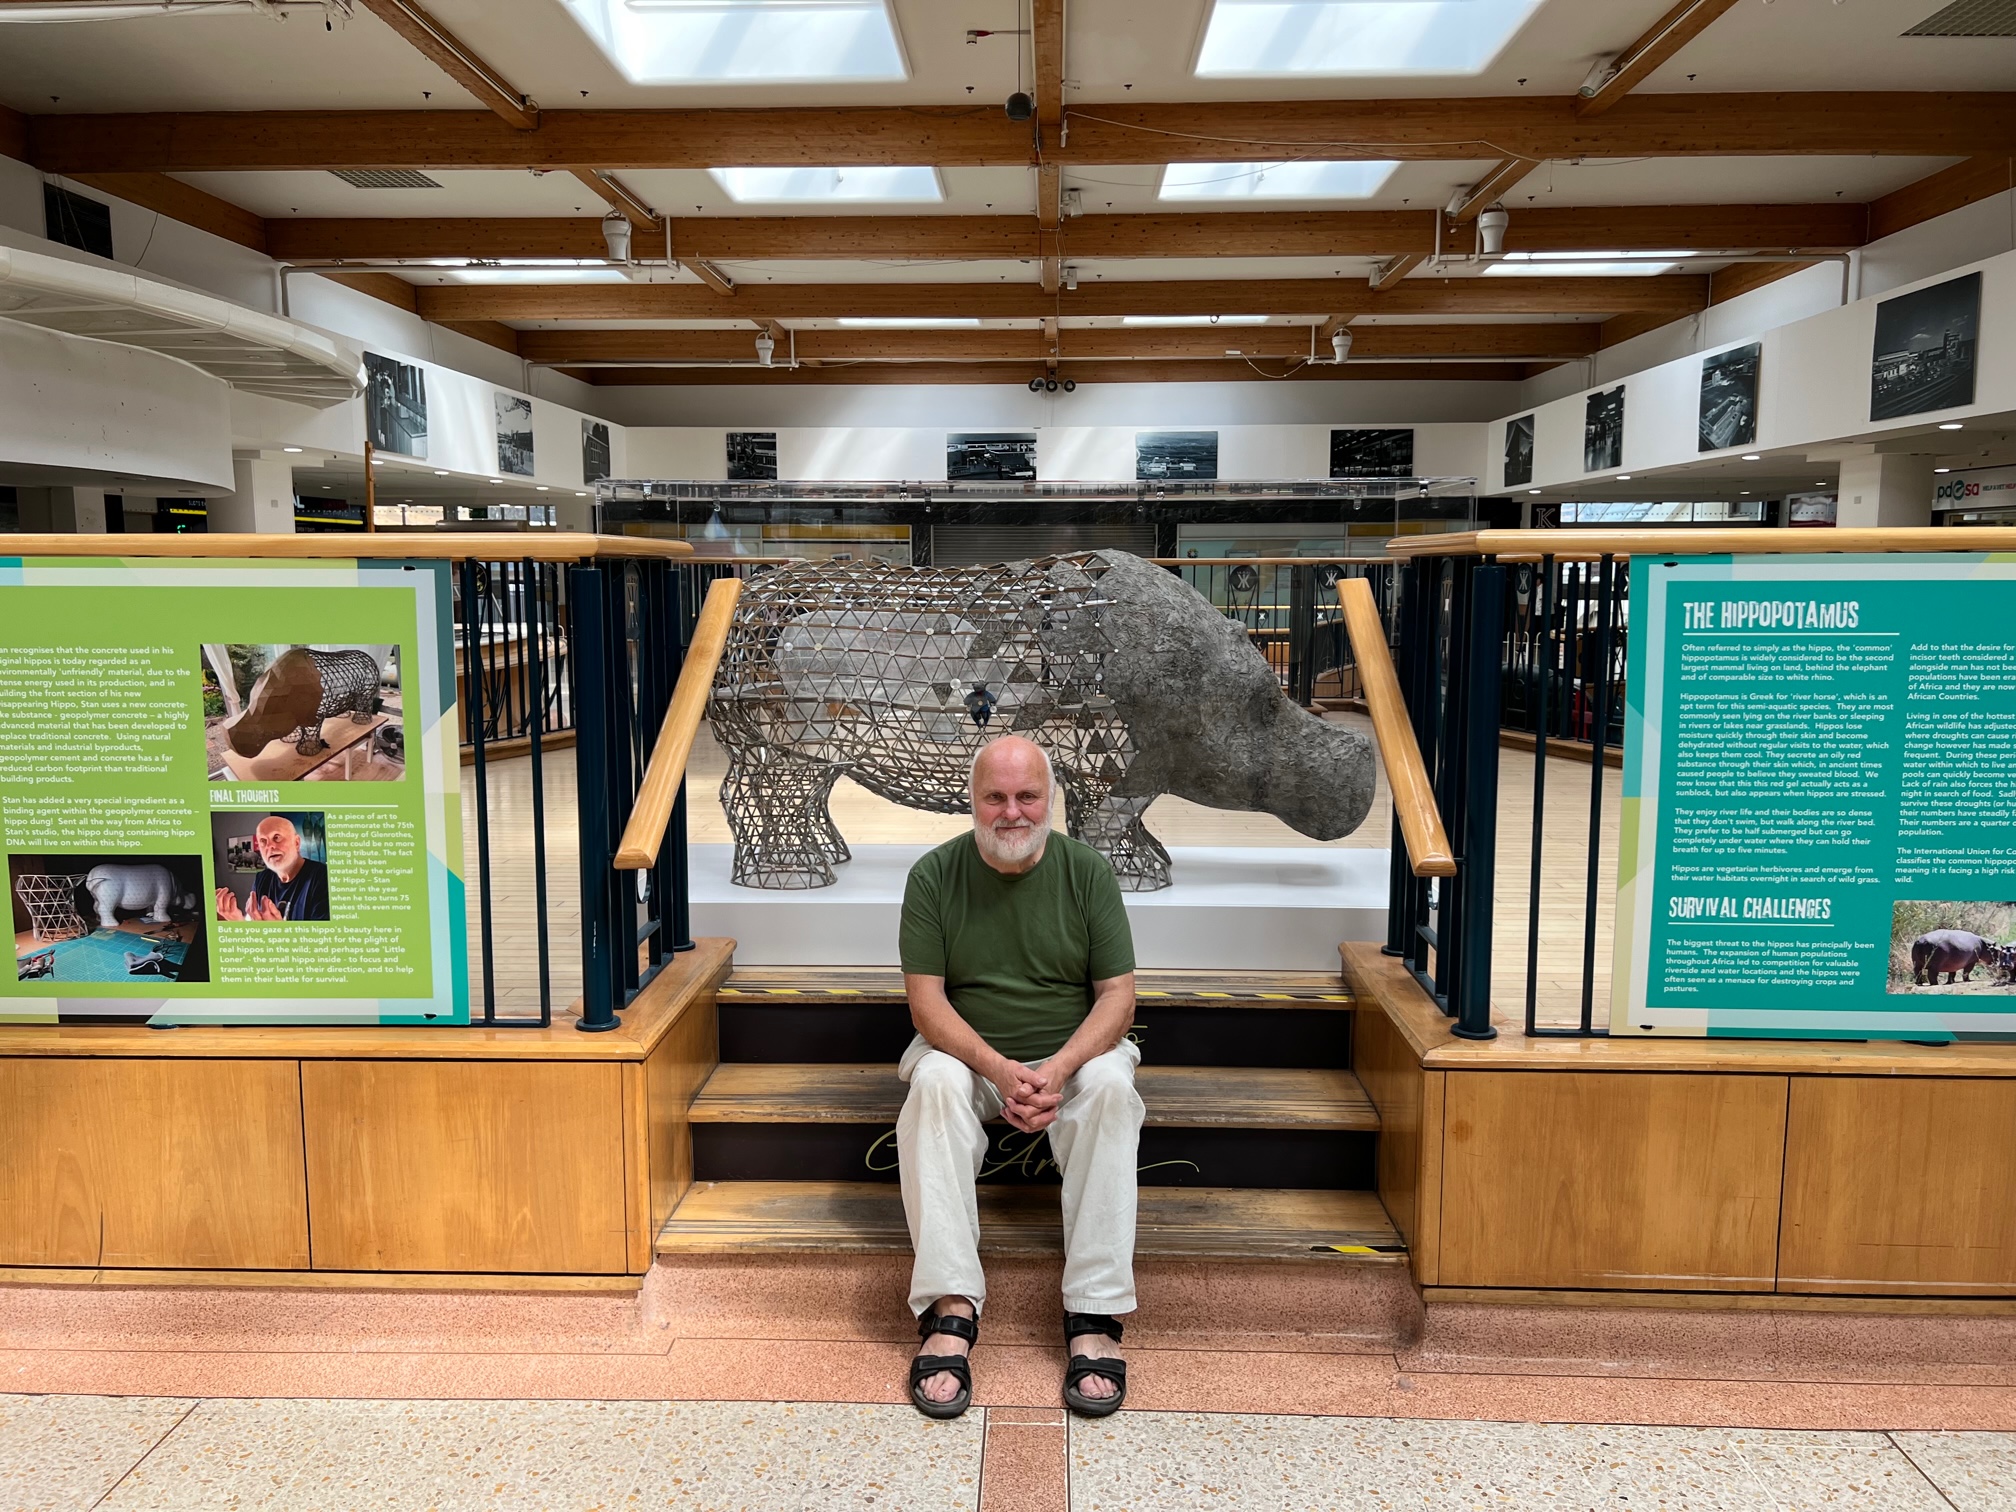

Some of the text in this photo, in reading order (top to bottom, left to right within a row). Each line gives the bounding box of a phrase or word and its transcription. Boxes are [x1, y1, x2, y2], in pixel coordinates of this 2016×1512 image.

[1536, 508, 1556, 528] K
[1683, 601, 1860, 629] THE HIPPOPOTAMUS
[1682, 643, 1704, 651] Often
[1707, 643, 1740, 651] referred
[1753, 644, 1779, 652] simply
[1808, 643, 1834, 652] hippo,
[1837, 643, 1850, 651] the
[1681, 663, 1708, 672] largest
[1747, 663, 1768, 672] living
[1783, 663, 1802, 671] land,
[1851, 663, 1887, 672] elephant
[1680, 693, 1738, 701] Hippopotamus
[1749, 692, 1773, 700] Greek
[1776, 692, 1787, 700] for
[1938, 692, 1981, 700] Countries.
[1906, 712, 1929, 721] Living
[1960, 711, 1968, 719] of
[0, 774, 73, 784] building products.
[210, 789, 279, 803] FINAL THOUGHTS
[1675, 807, 1693, 816] They
[4, 817, 27, 826] hippo
[30, 817, 52, 826] dung!
[106, 819, 122, 827] way
[124, 817, 144, 825] from
[146, 817, 170, 825] Africa
[5, 827, 29, 835] Stan's
[77, 828, 100, 837] hippo
[103, 828, 124, 837] dung
[126, 828, 169, 837] containing
[171, 828, 195, 837] hippo
[328, 831, 359, 839] birthday
[1898, 828, 1943, 836] population.
[73, 838, 97, 846] within
[100, 838, 114, 846] this
[117, 839, 143, 847] hippo.
[329, 848, 352, 857] fitting
[360, 867, 369, 875] by
[385, 867, 413, 875] original
[1672, 864, 1699, 873] Hippos
[1716, 865, 1757, 874] vegetarian
[1821, 867, 1852, 875] emerge
[1668, 896, 1832, 919] SURVIVAL CHALLENGES
[218, 925, 231, 933] But
[262, 927, 281, 935] gaze
[295, 925, 309, 933] this
[311, 925, 341, 934] hippo's
[344, 926, 371, 934] beauty
[374, 925, 391, 933] here
[1683, 939, 1712, 948] biggest
[1767, 940, 1793, 948] hippos
[1811, 940, 1852, 949] principally
[1666, 957, 1709, 966] throughout
[1711, 957, 1734, 965] Africa
[1762, 959, 1809, 967] competition
